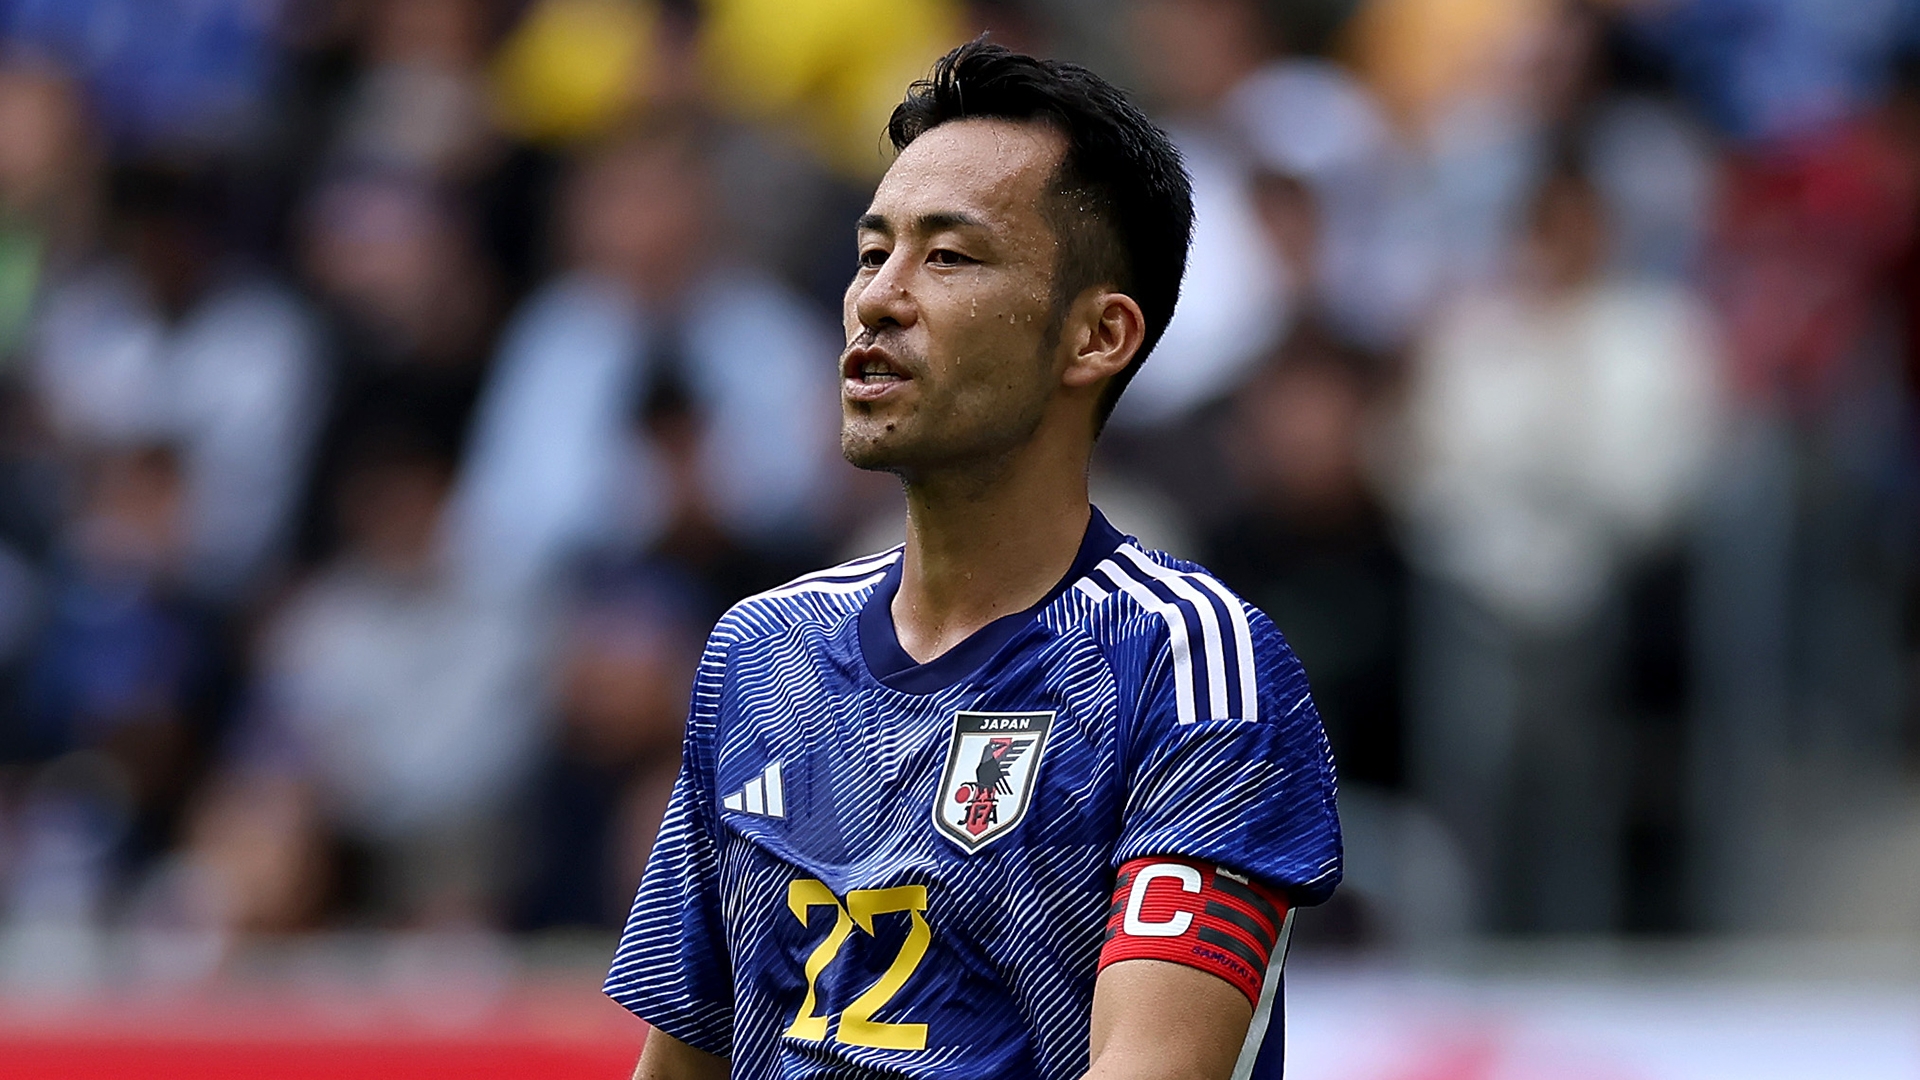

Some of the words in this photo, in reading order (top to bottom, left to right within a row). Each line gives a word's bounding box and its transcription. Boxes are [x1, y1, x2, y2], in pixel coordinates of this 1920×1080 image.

[980, 718, 1030, 730] JAPAN
[956, 803, 998, 826] JFA
[1123, 863, 1202, 937] C
[781, 878, 932, 1051] 22
